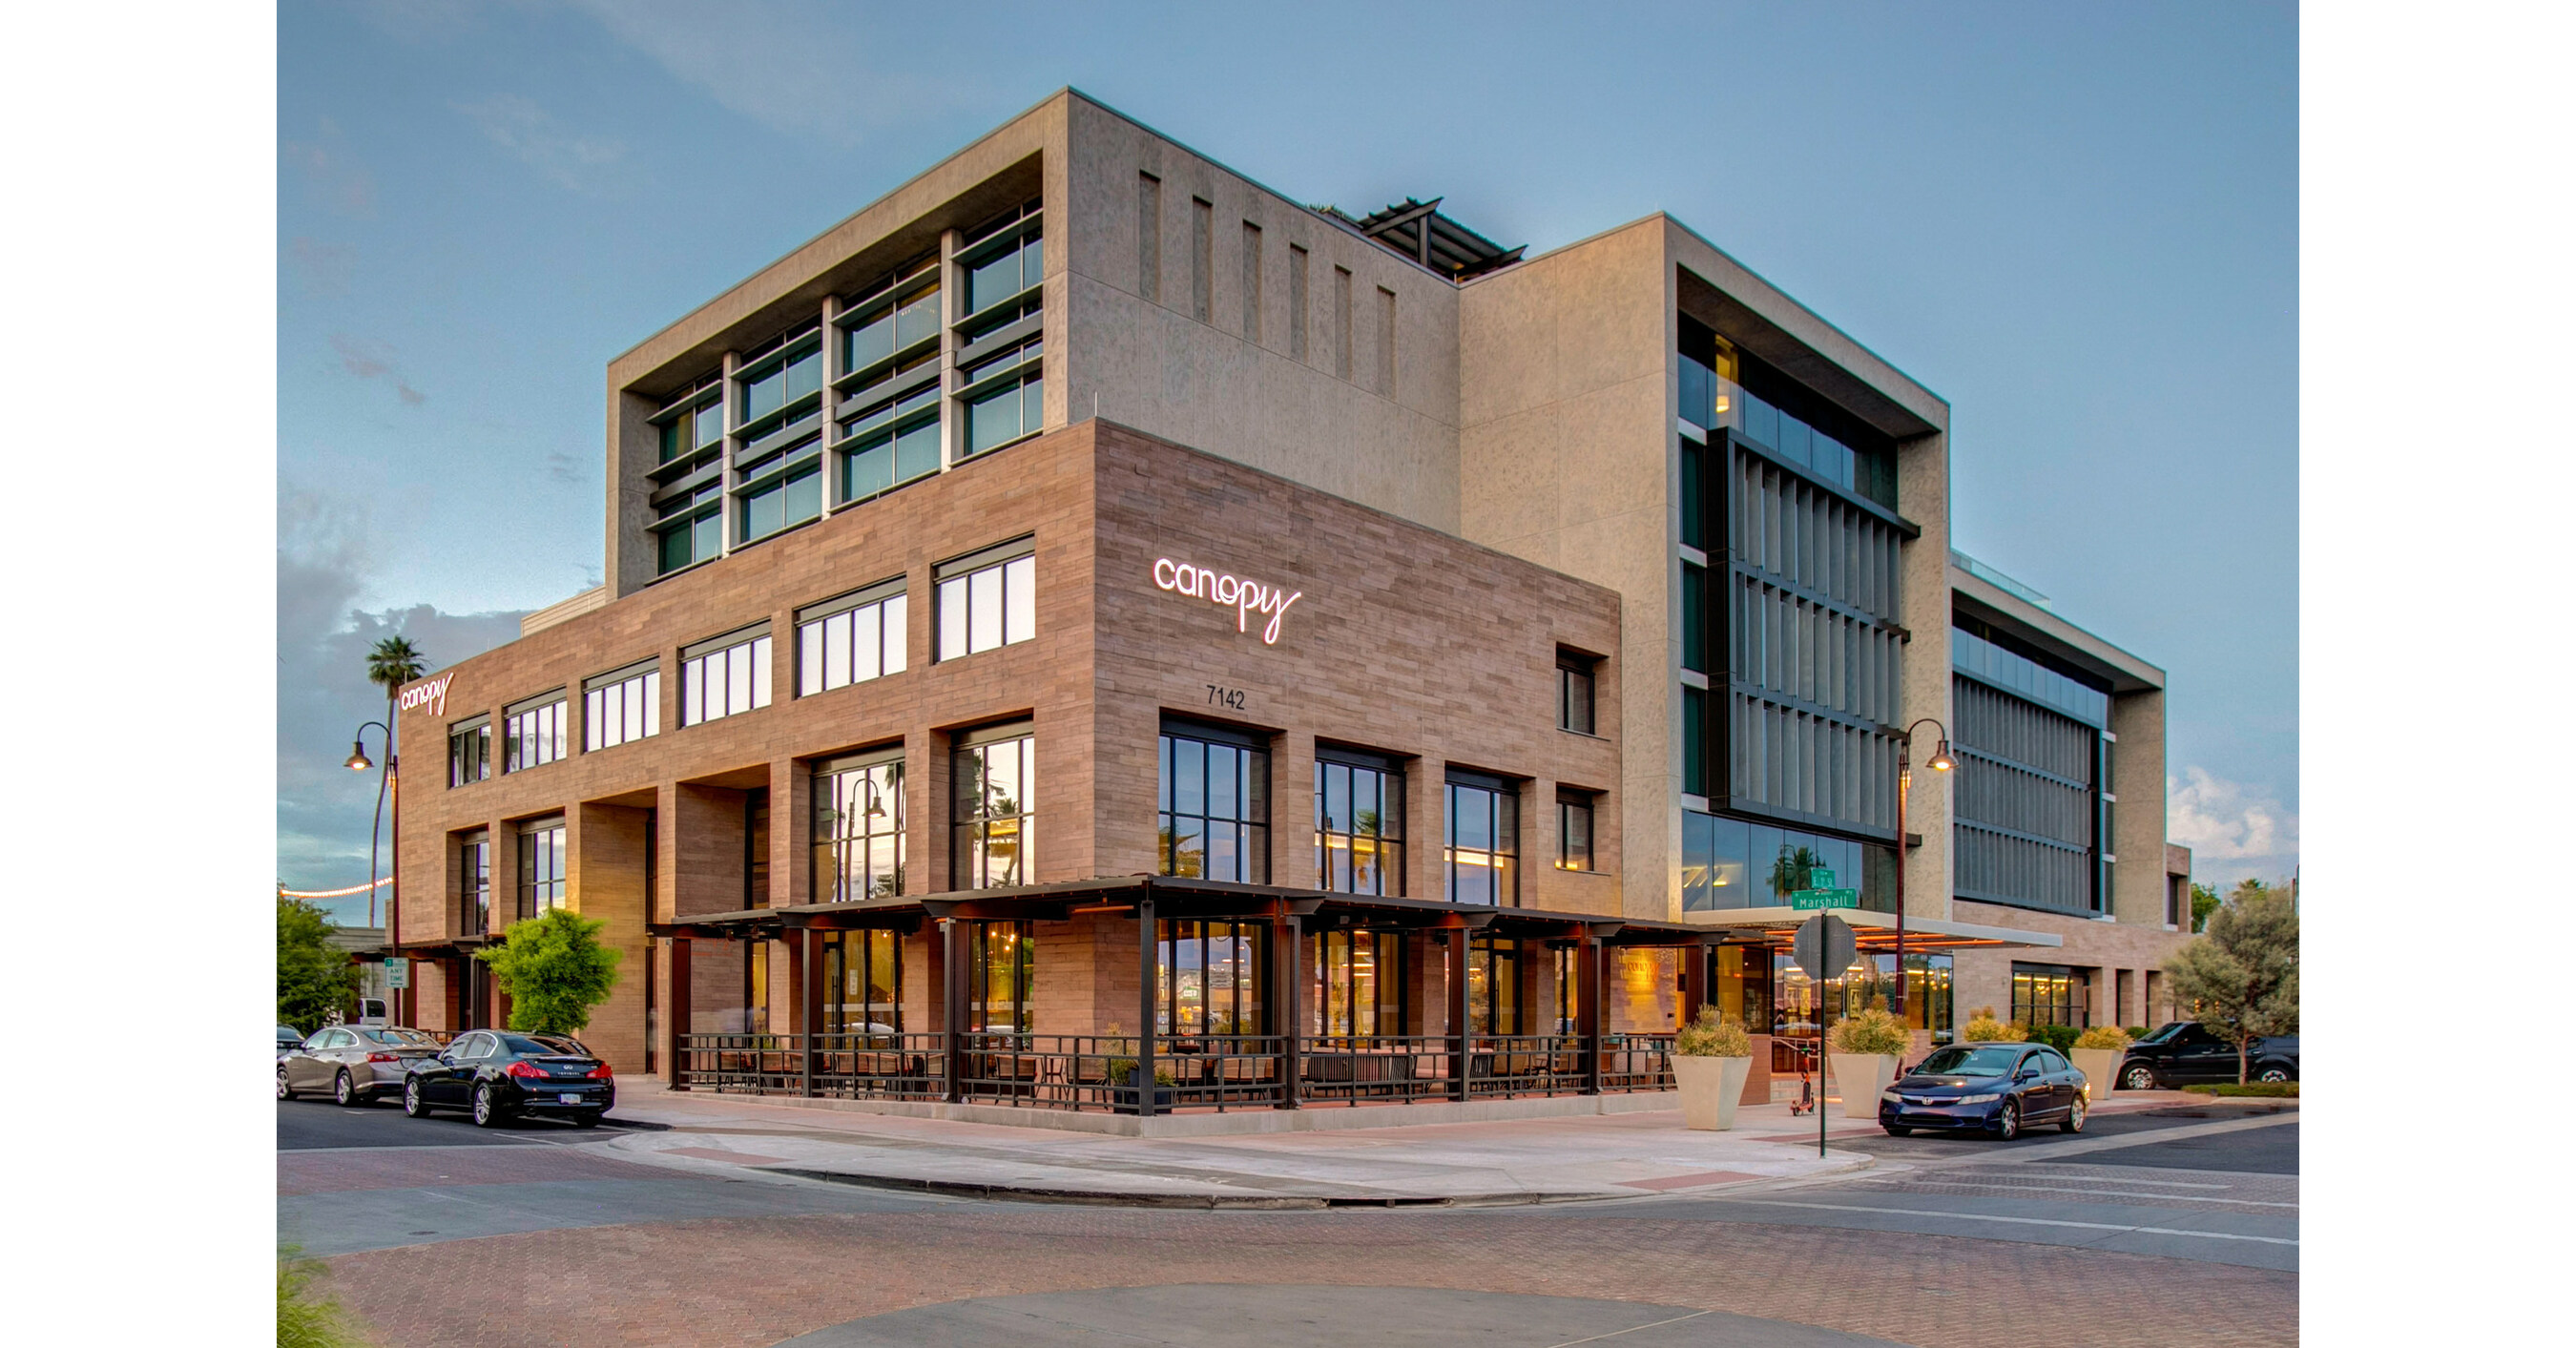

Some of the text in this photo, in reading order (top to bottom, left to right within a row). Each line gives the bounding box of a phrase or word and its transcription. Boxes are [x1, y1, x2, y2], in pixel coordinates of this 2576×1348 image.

[1153, 558, 1302, 645] canopy
[401, 672, 454, 716] canopy
[1206, 685, 1245, 711] 7142
[1799, 895, 1848, 908] Marshall
[1627, 961, 1661, 983] canopy
